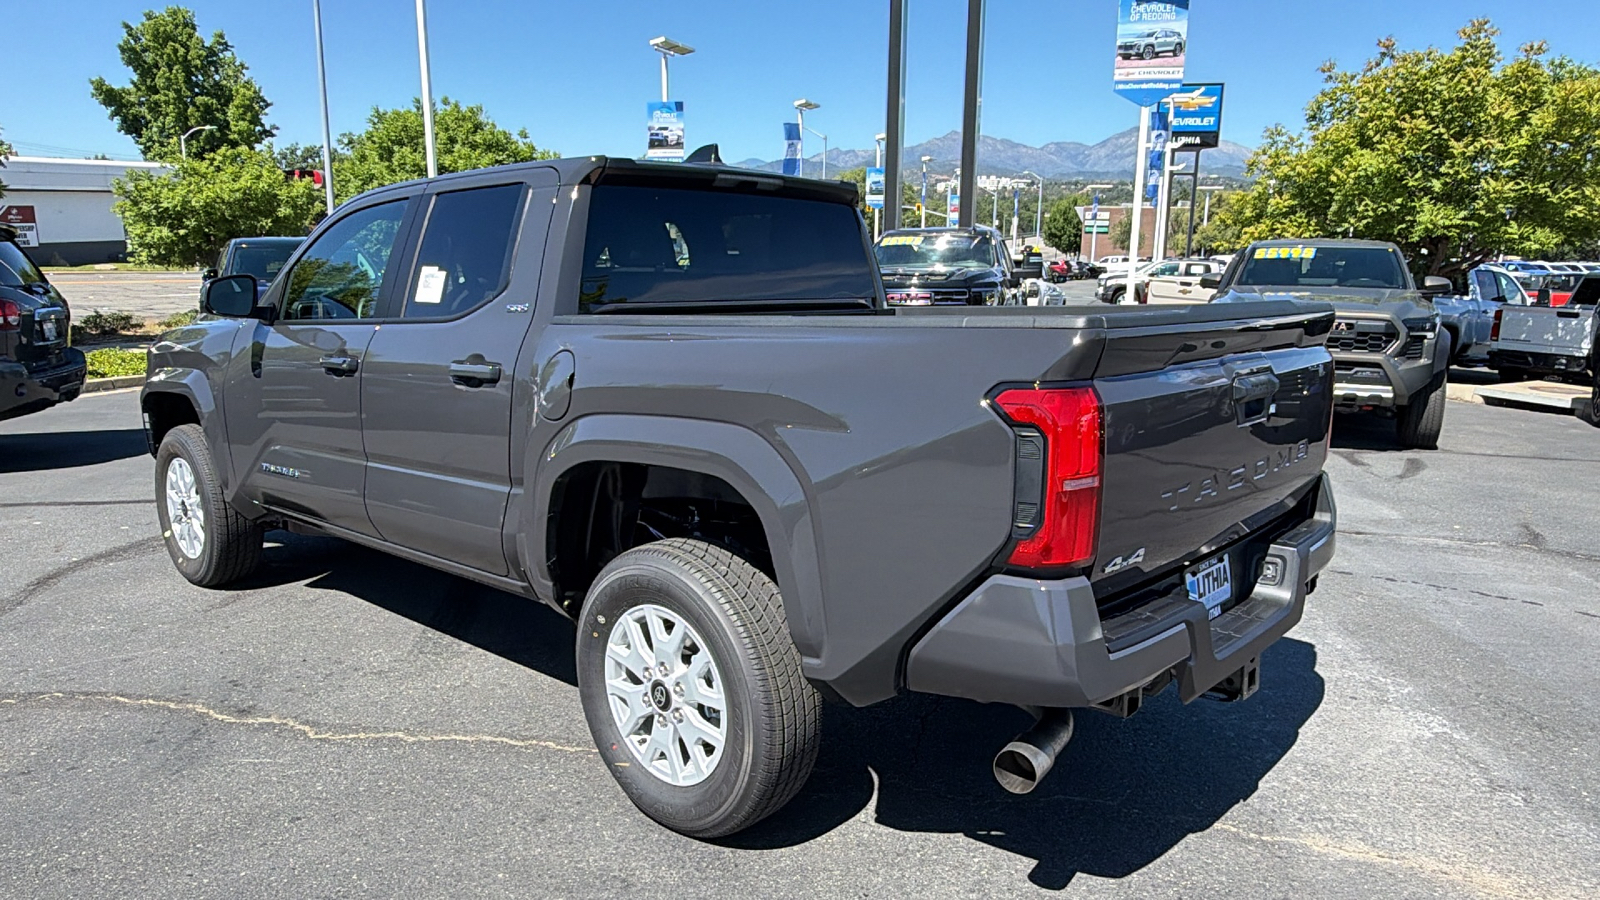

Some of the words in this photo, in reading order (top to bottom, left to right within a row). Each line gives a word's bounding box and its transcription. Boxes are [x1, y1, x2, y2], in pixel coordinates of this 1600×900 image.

[1130, 4, 1176, 14] CHEVROLET
[1130, 13, 1141, 22] OF
[1142, 12, 1176, 21] REDDING
[1172, 116, 1216, 126] EVROLET
[887, 294, 931, 306] GMC
[1160, 438, 1309, 511] TACOMA
[1195, 562, 1230, 600] LITHIA
